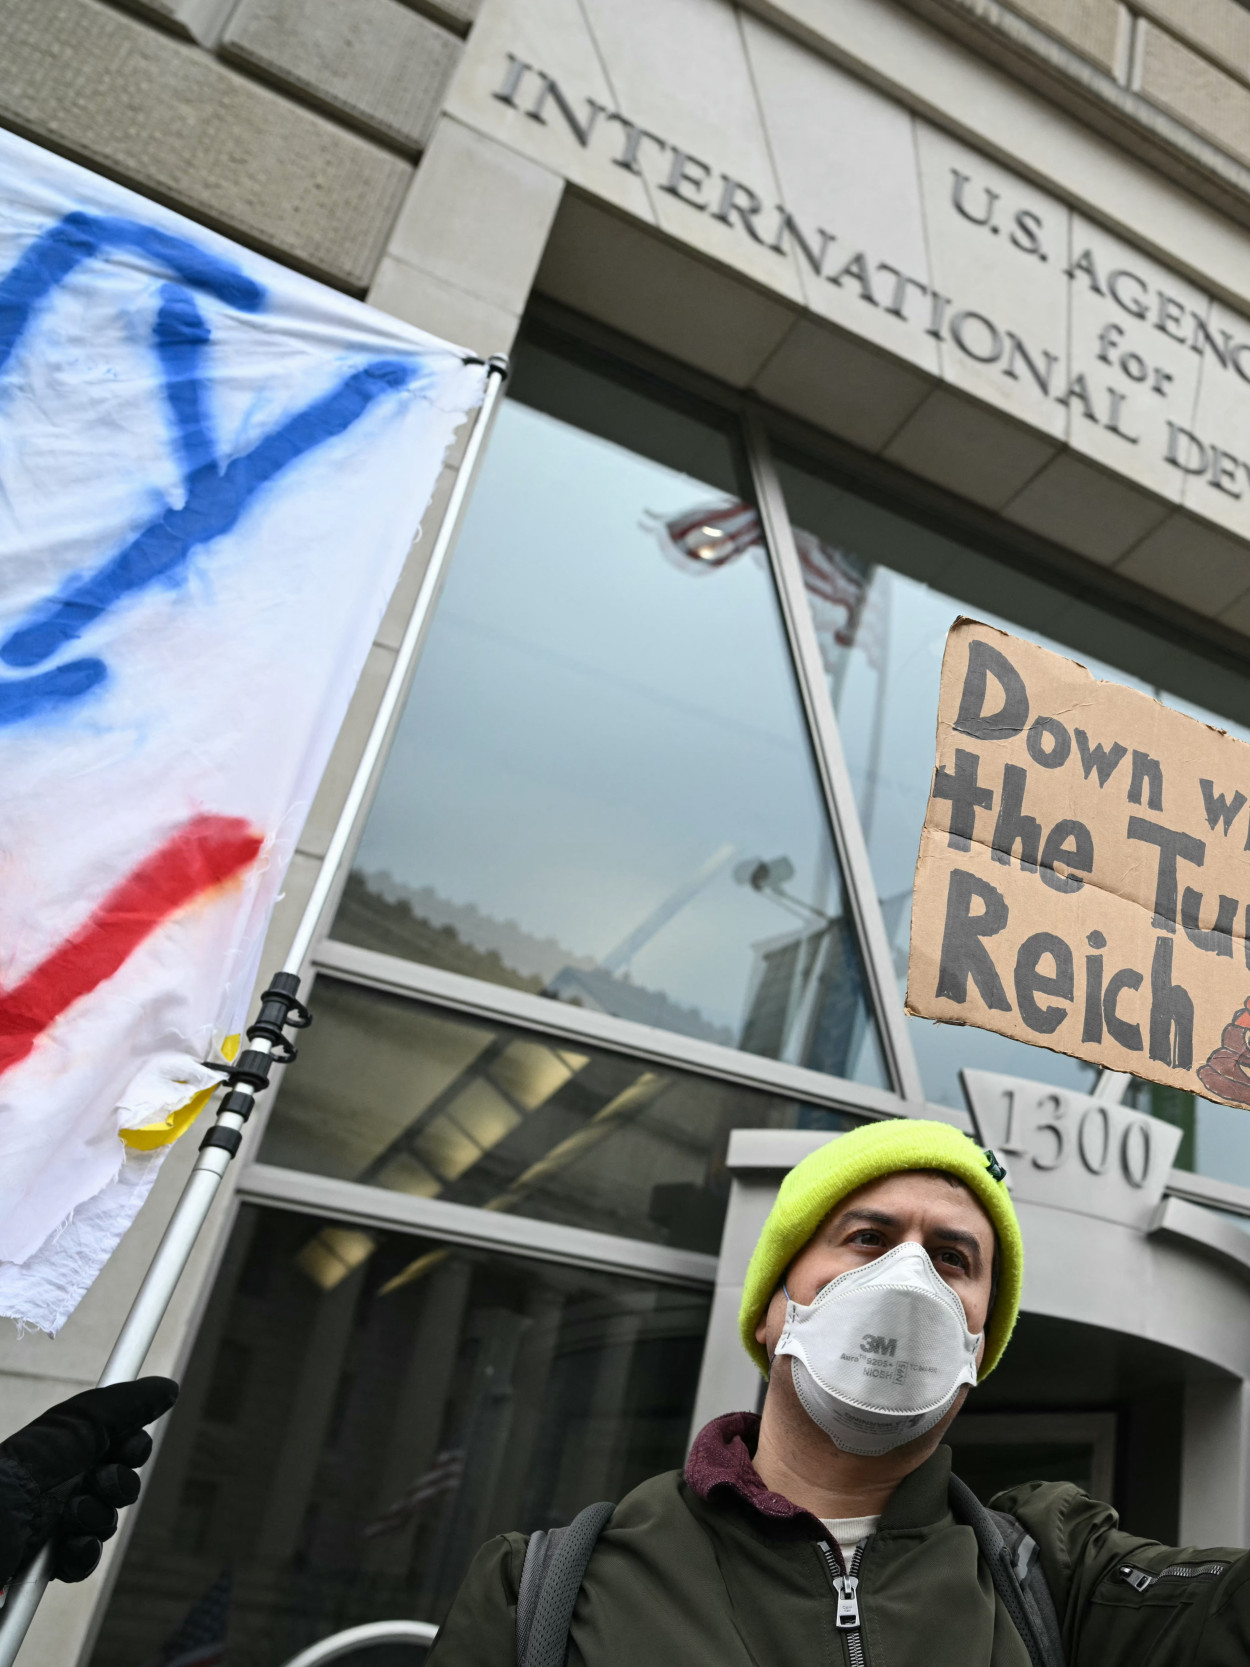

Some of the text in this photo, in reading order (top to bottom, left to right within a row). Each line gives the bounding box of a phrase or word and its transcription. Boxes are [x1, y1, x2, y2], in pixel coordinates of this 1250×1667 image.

[490, 52, 1140, 444] INTERNATIONAL
[949, 168, 1049, 262] U.S.
[1097, 322, 1173, 398] for
[952, 639, 1164, 811] Down
[932, 748, 1094, 894] the
[935, 868, 1194, 1071] Reich
[998, 1088, 1151, 1190] 1300
[860, 1334, 897, 1357] 3M
